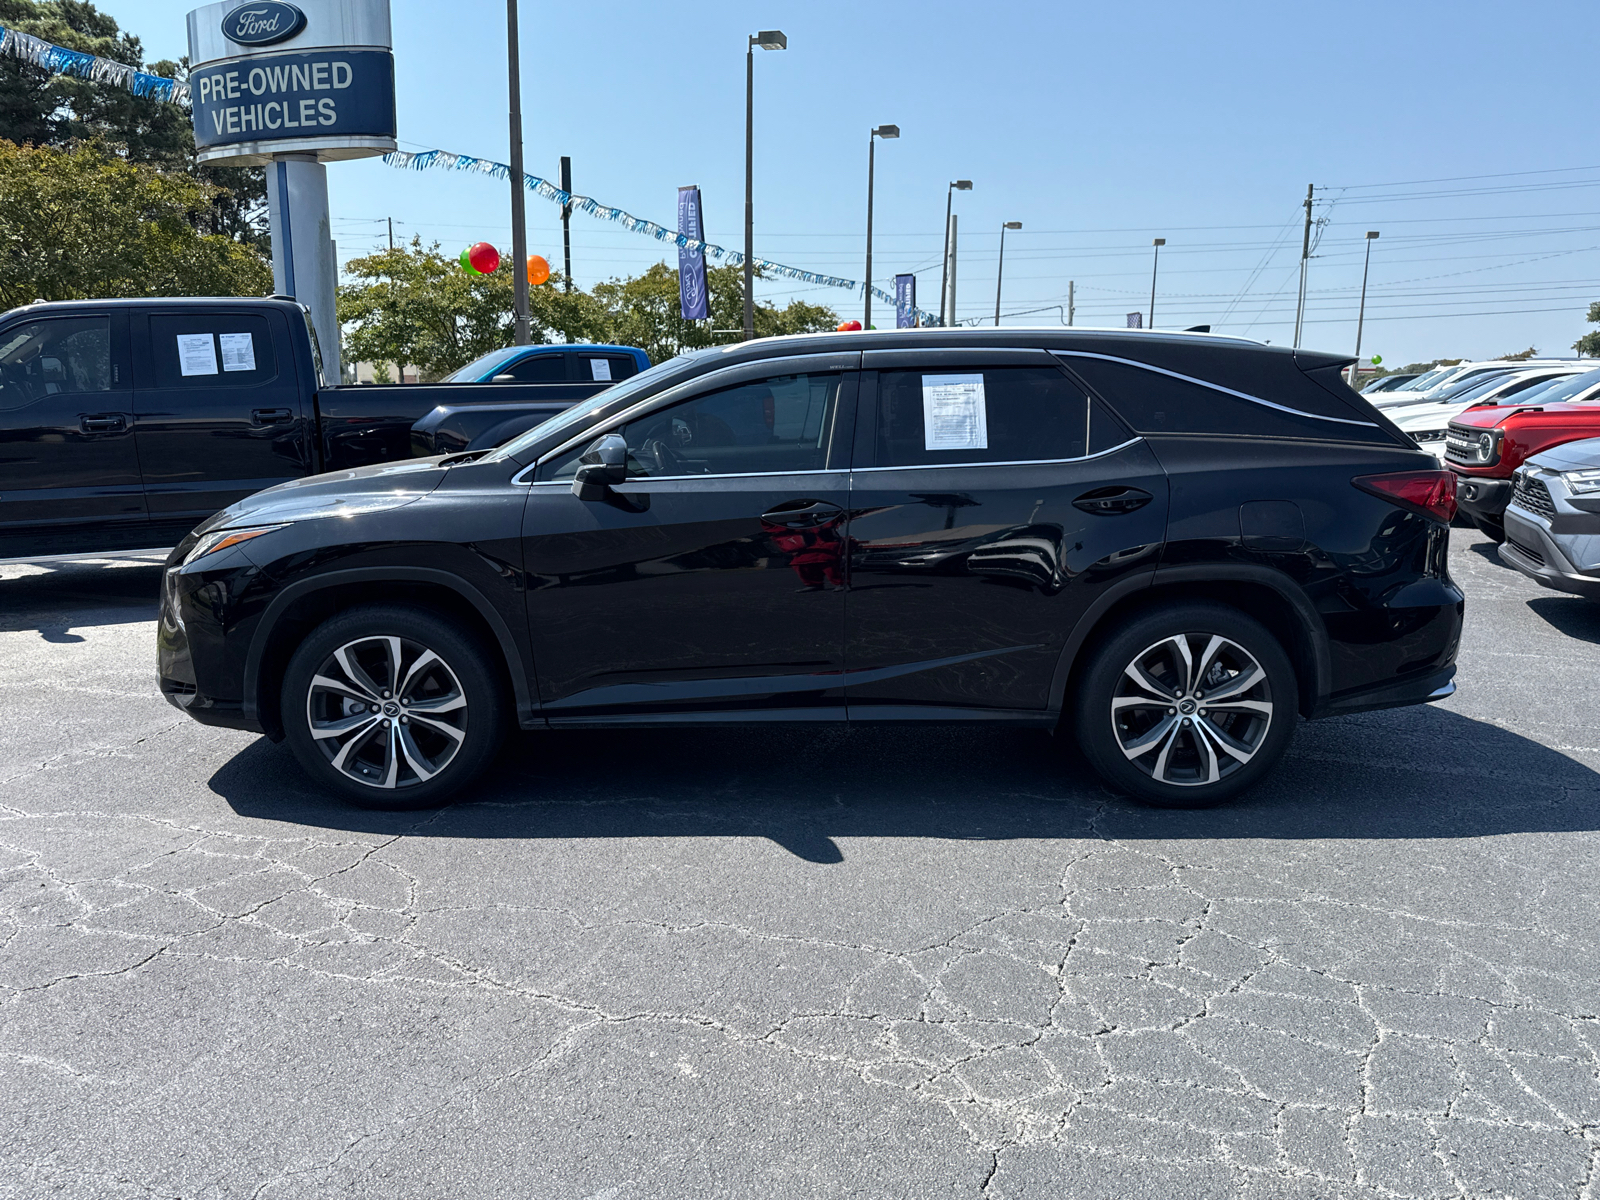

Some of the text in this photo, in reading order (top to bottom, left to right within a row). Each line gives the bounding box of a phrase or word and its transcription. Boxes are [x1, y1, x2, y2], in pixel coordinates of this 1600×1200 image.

[236, 9, 280, 37] Ford
[200, 61, 353, 104] PRE-OWNED
[212, 98, 337, 135] VEHICLES
